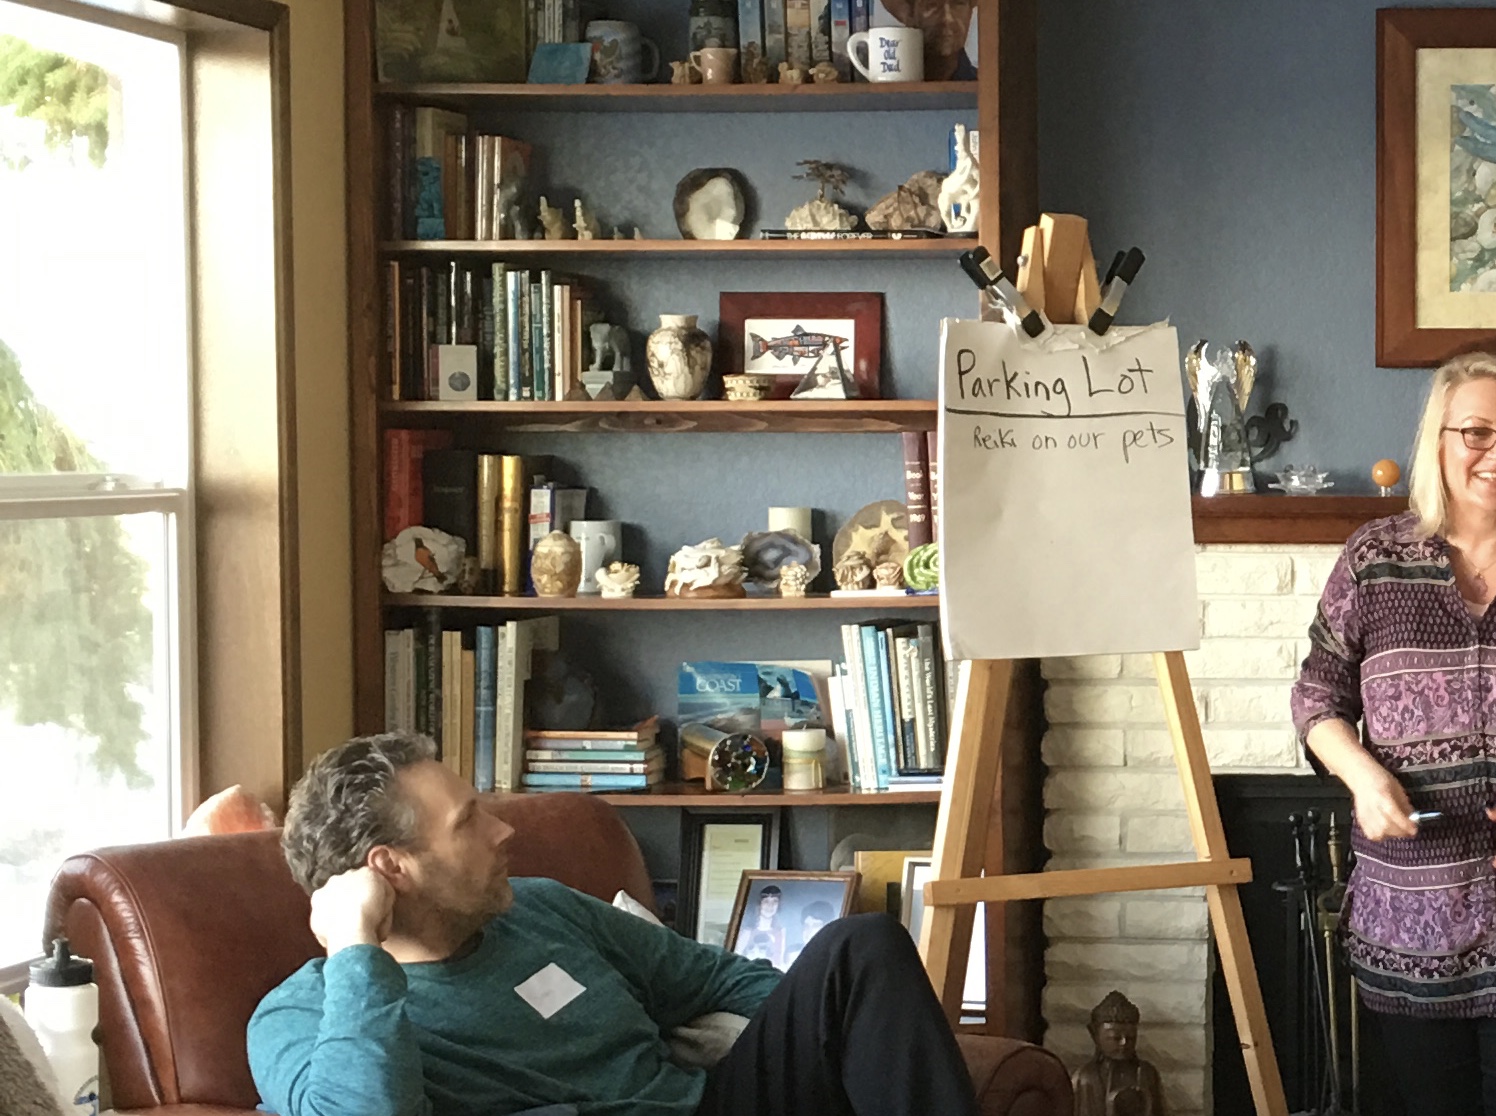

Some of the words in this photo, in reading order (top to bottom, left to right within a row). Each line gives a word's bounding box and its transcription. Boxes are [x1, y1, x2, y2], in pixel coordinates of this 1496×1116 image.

[879, 37, 899, 48] Dear
[884, 48, 896, 60] Old
[880, 60, 901, 73] Dad
[956, 348, 1072, 416] Parking
[1081, 355, 1154, 398] Lot
[1032, 434, 1057, 450] on
[1067, 431, 1106, 450] our
[1122, 421, 1175, 464] pets
[696, 678, 742, 693] COAST
